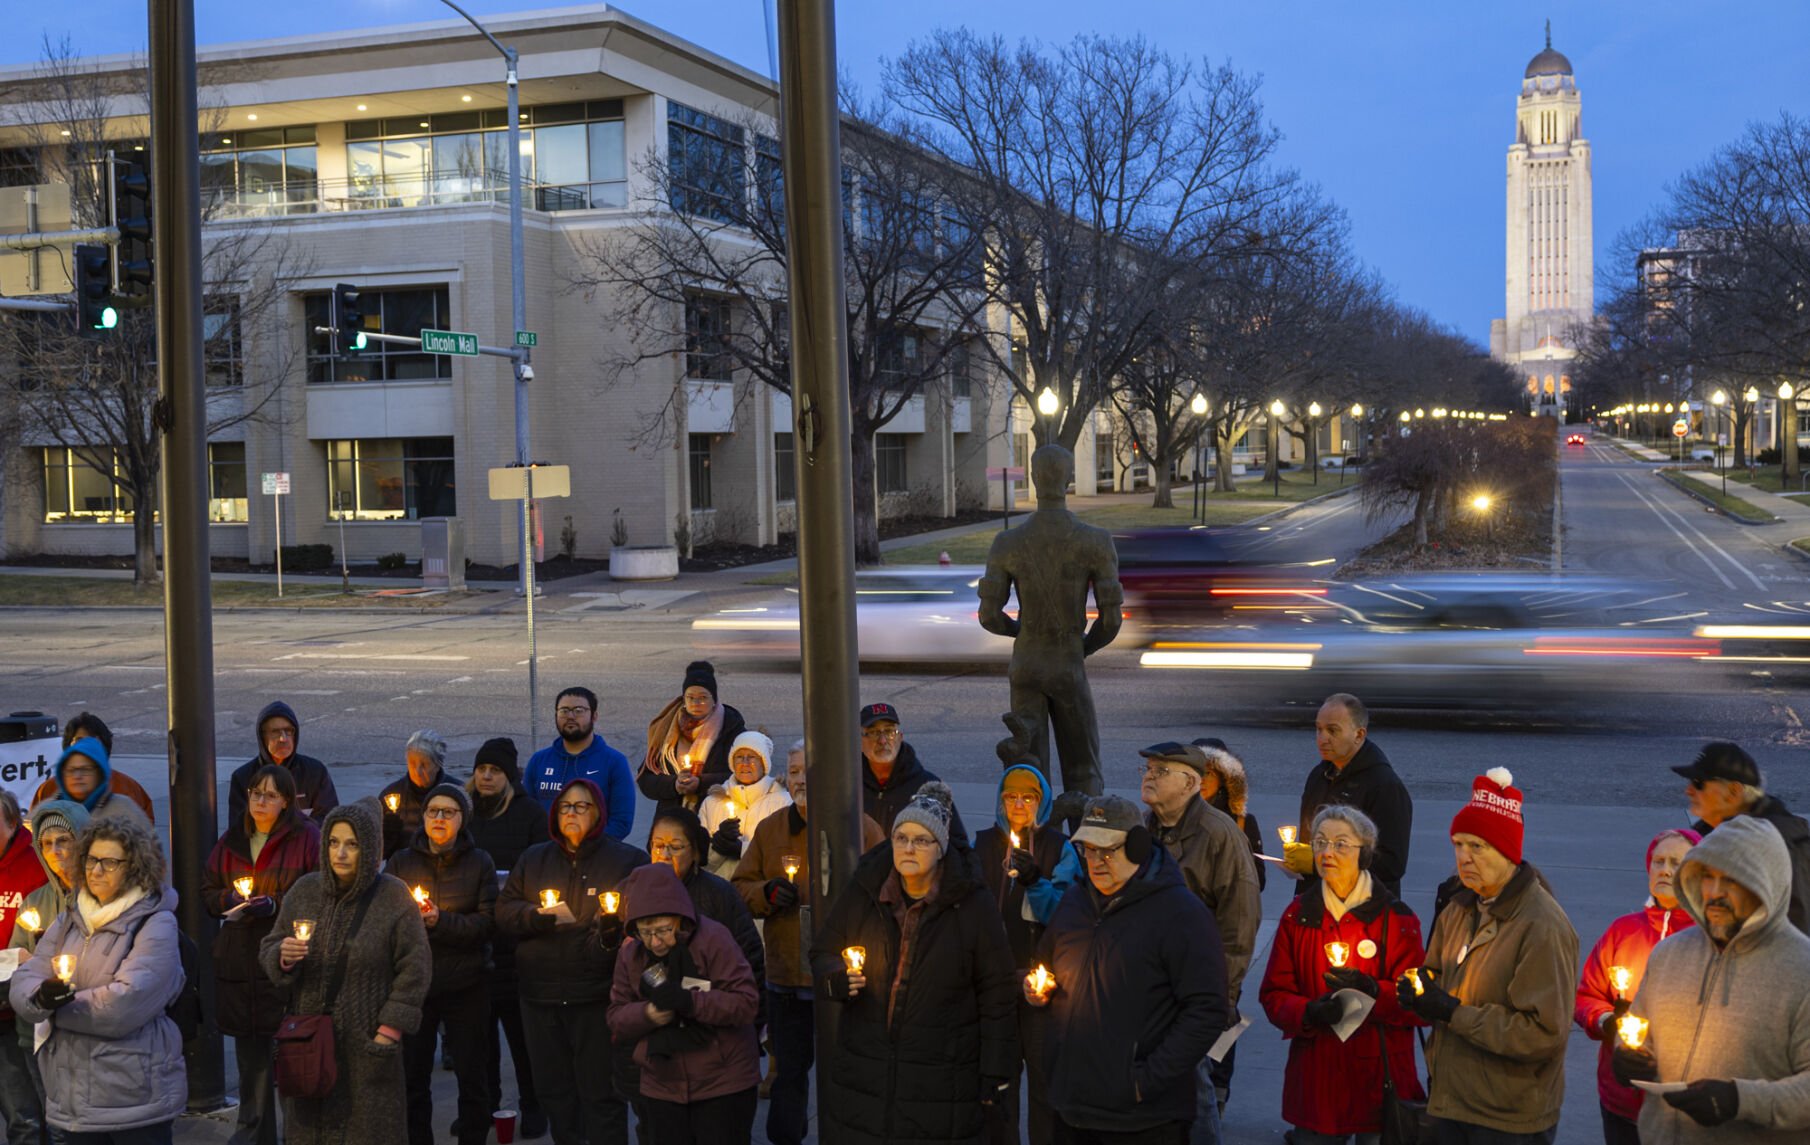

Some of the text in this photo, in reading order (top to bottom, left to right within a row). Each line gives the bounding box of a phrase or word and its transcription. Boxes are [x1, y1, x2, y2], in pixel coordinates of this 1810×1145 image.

[425, 333, 476, 353] Lincoln Mall
[518, 334, 530, 345] 600
[0, 754, 52, 783] ert,
